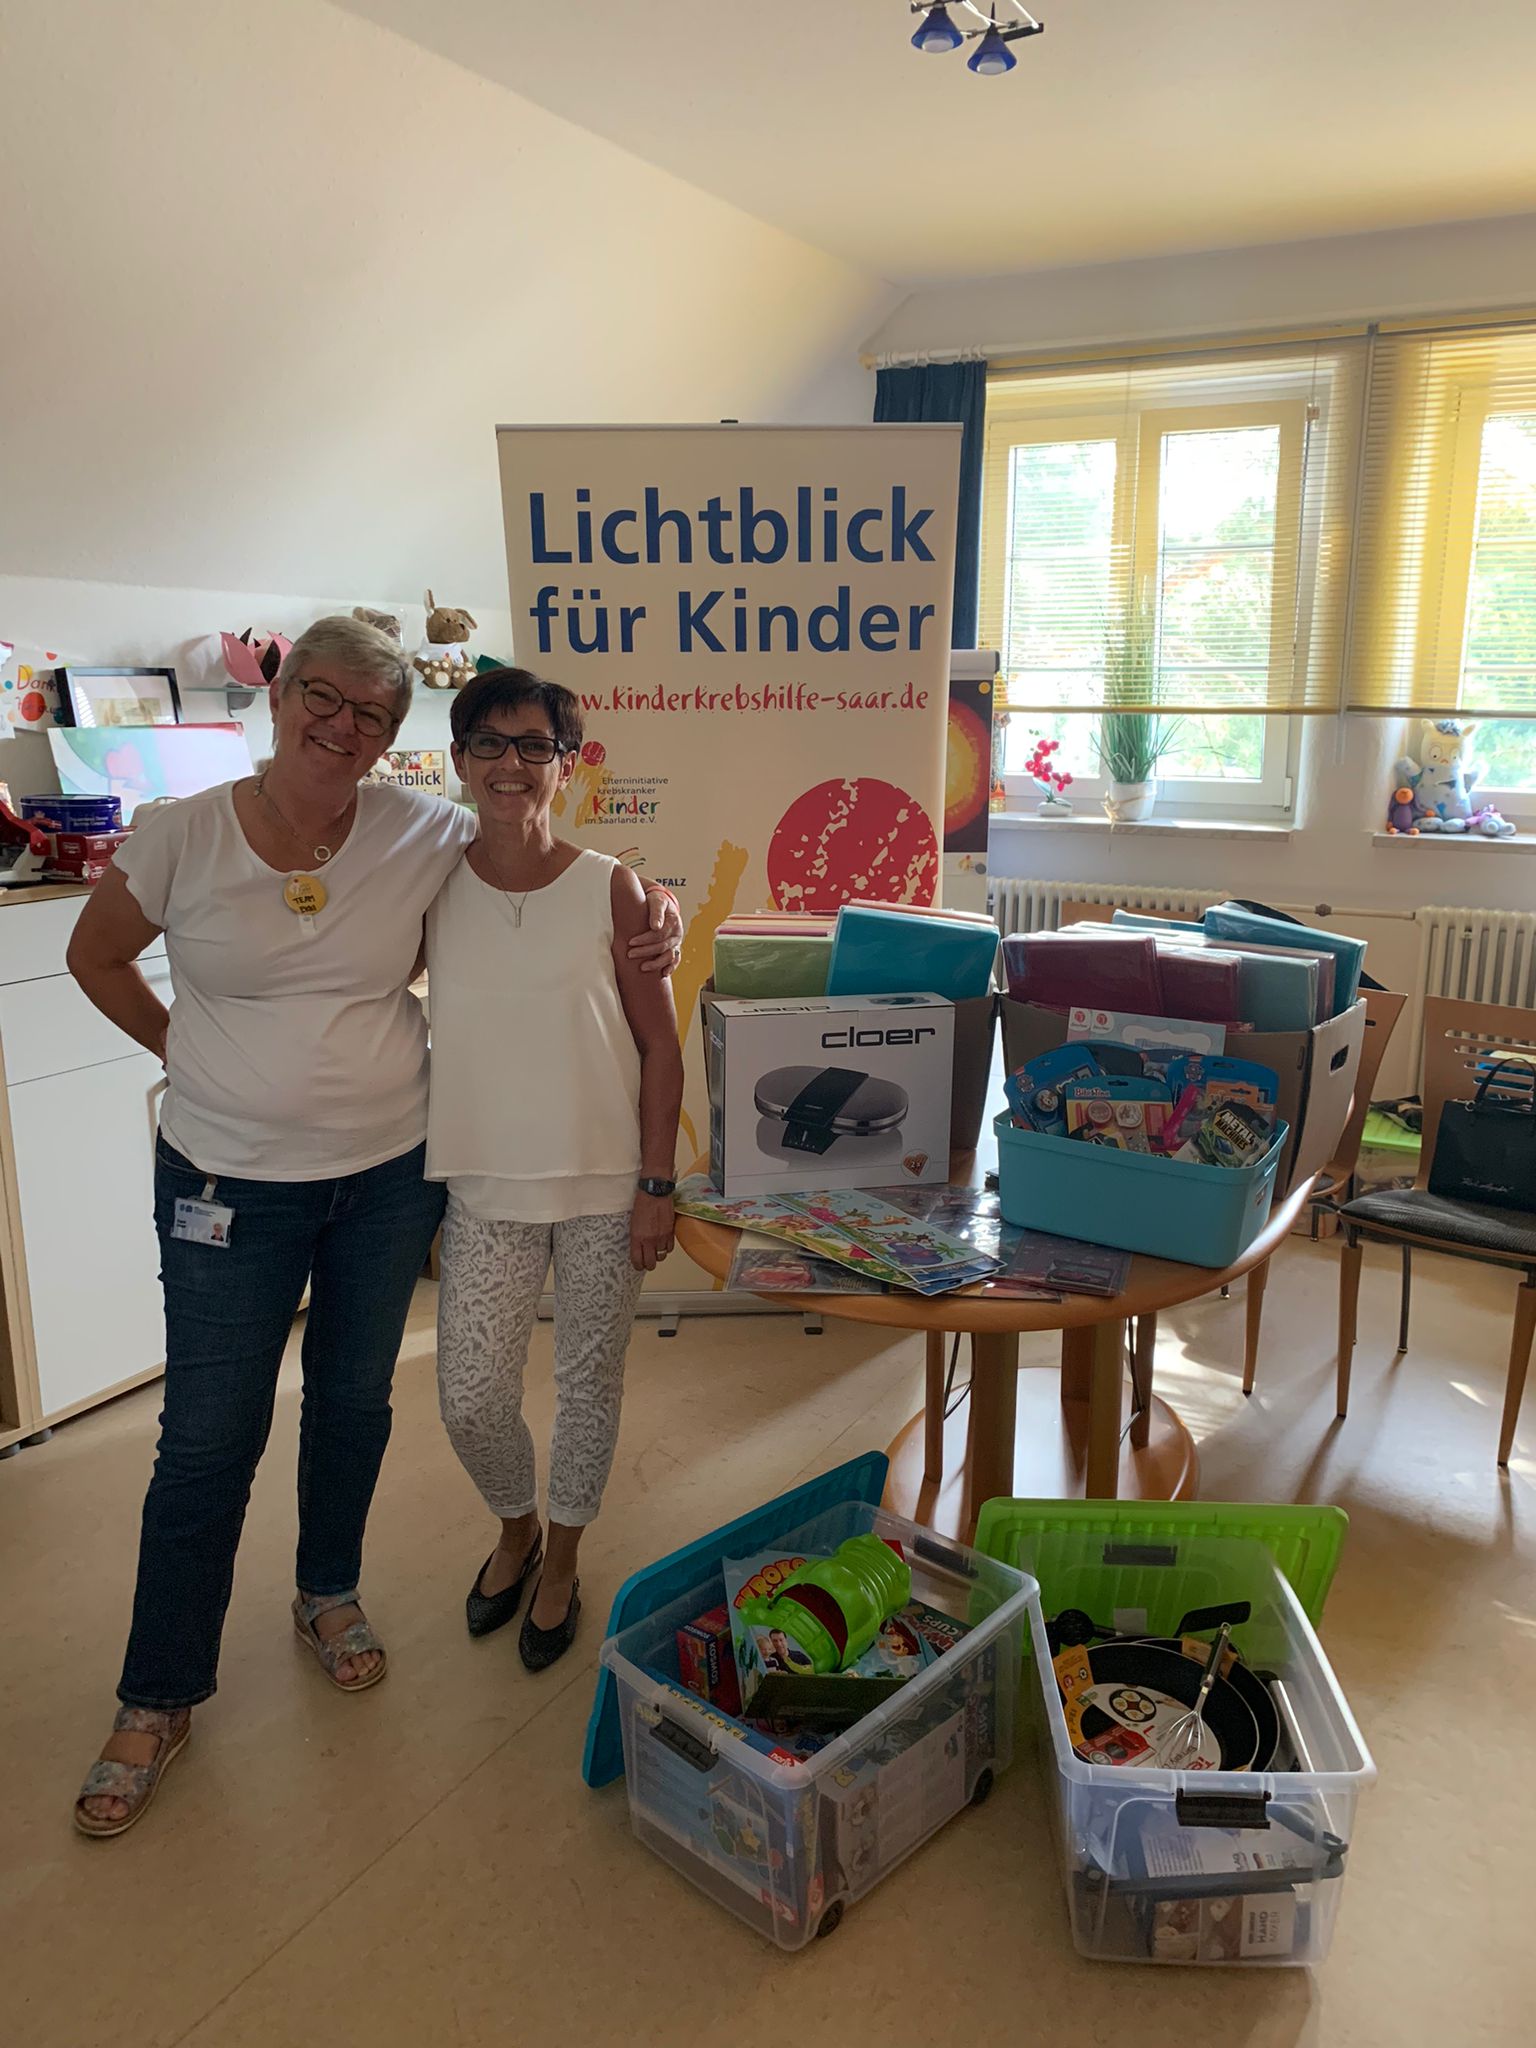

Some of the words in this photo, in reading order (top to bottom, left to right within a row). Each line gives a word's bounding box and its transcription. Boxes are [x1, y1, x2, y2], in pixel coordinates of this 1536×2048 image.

[530, 486, 936, 564] Lichtblick
[529, 586, 646, 655] für
[678, 585, 936, 654] Kinder
[576, 682, 929, 714] w.kinderkrebshilfe-saar.de
[597, 786, 657, 795] krebskranker
[602, 776, 669, 785] Elterninitiative
[592, 795, 661, 815] Kinder
[584, 816, 596, 825] im
[599, 816, 638, 825] Saarland
[821, 1026, 936, 1049] cloer
[1214, 1119, 1250, 1151] MACHINES
[1220, 1111, 1255, 1145] METAL
[922, 1614, 960, 1636] CUPS
[708, 1641, 720, 1685] KOSMOS
